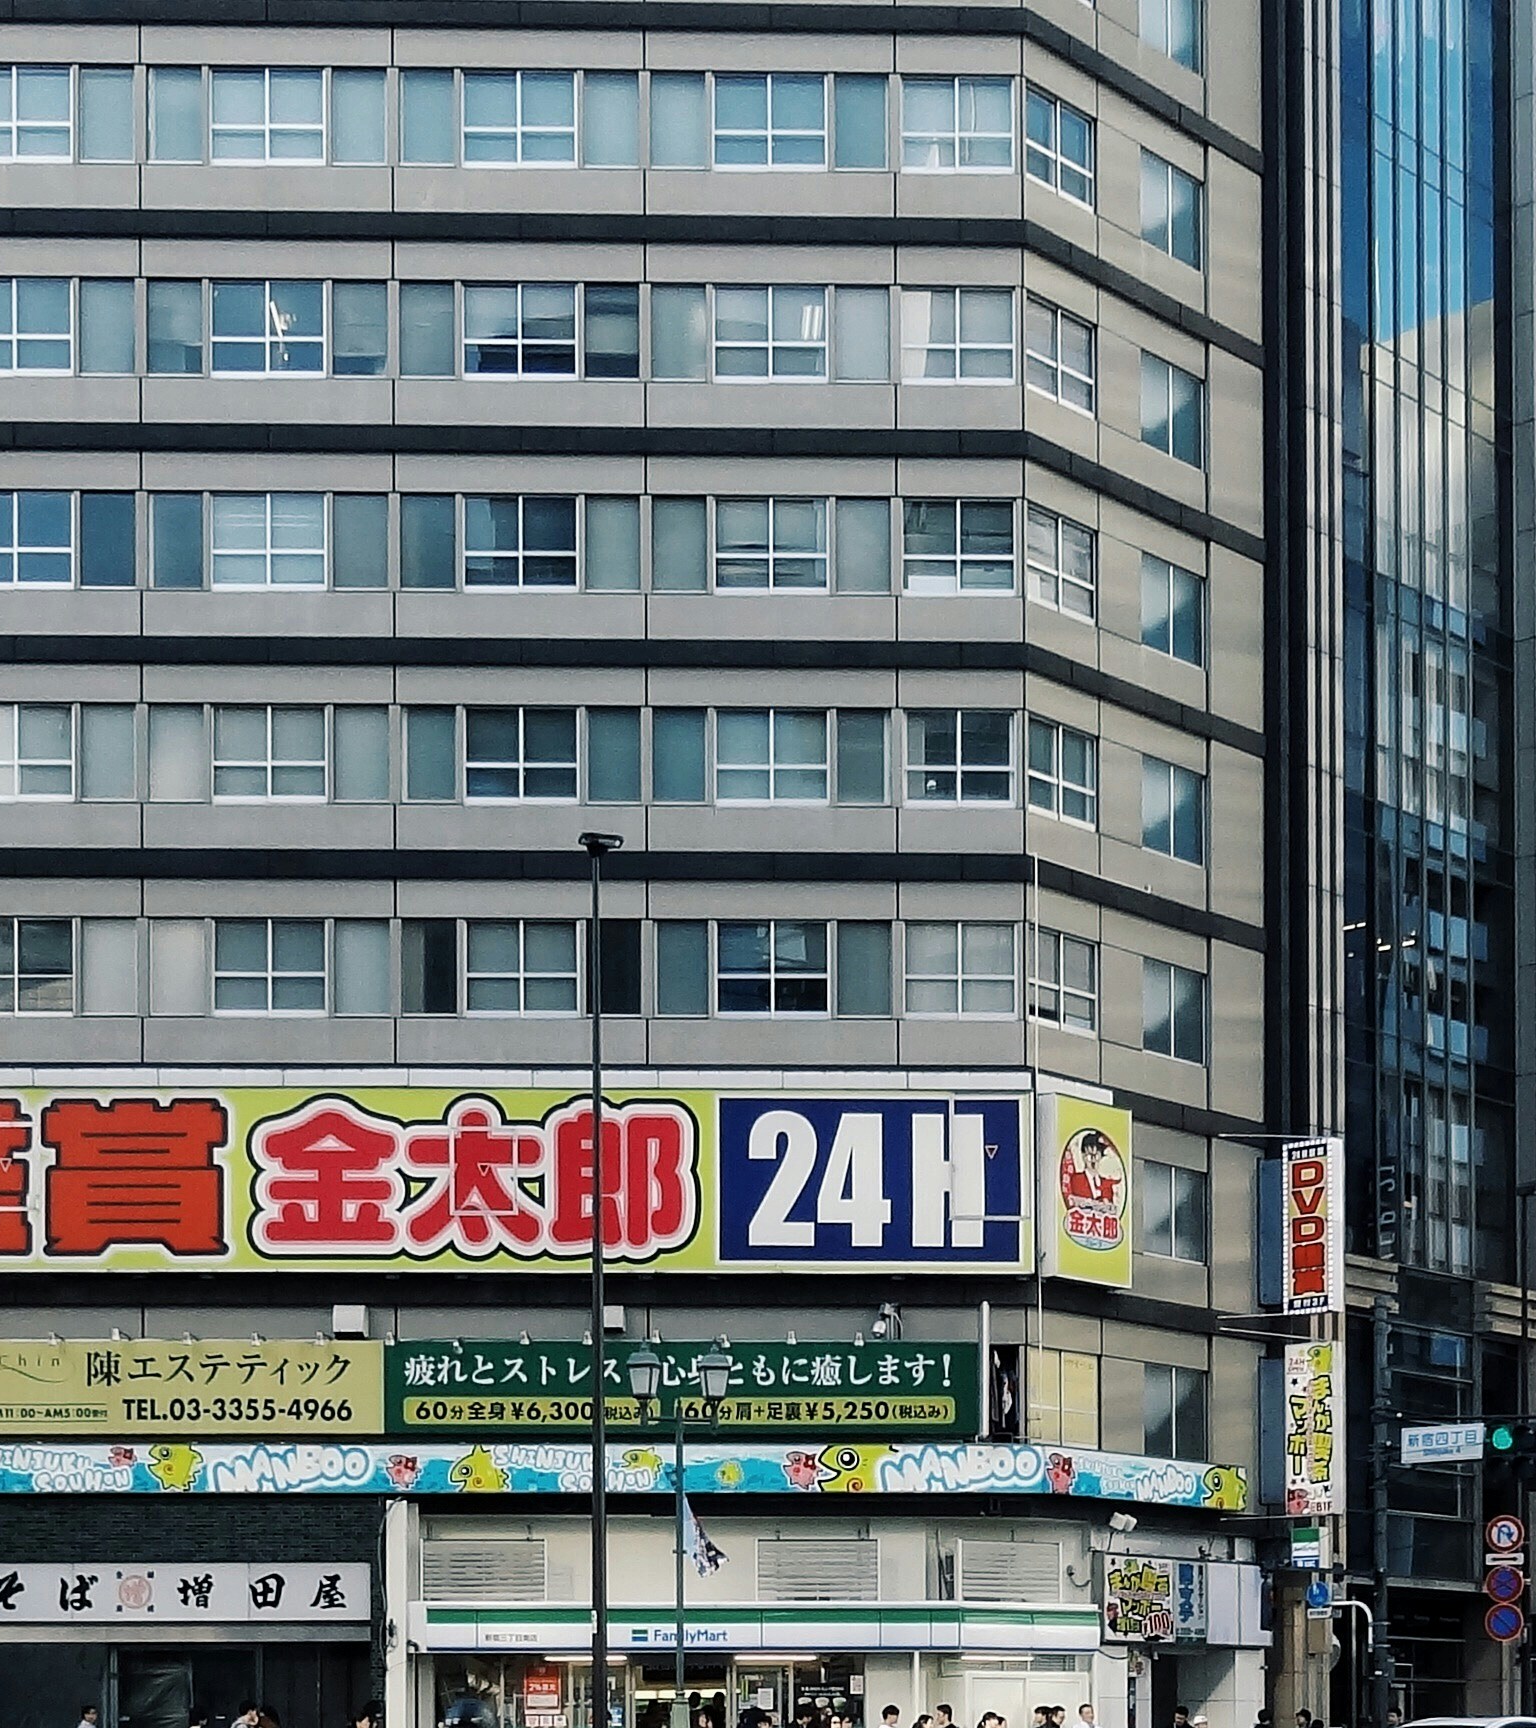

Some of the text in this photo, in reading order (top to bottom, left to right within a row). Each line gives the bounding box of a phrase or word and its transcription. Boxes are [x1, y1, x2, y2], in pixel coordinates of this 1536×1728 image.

[254, 1100, 696, 1258] 金太郎
[746, 1108, 988, 1249] 24H
[1068, 1209, 1119, 1241] 金太郎
[86, 1350, 352, 1388] 陳エステティック
[122, 1398, 353, 1422] TEL.03-3355-4966
[1408, 1429, 1477, 1447] 新宿四丁目
[213, 1443, 368, 1492] MANBOO
[491, 1445, 611, 1472] SHINJUK
[879, 1443, 1041, 1492] MANBOO
[560, 1468, 653, 1491] SOHON
[177, 1573, 350, 1610] 増田屋
[653, 1629, 729, 1645] FamlyMart
